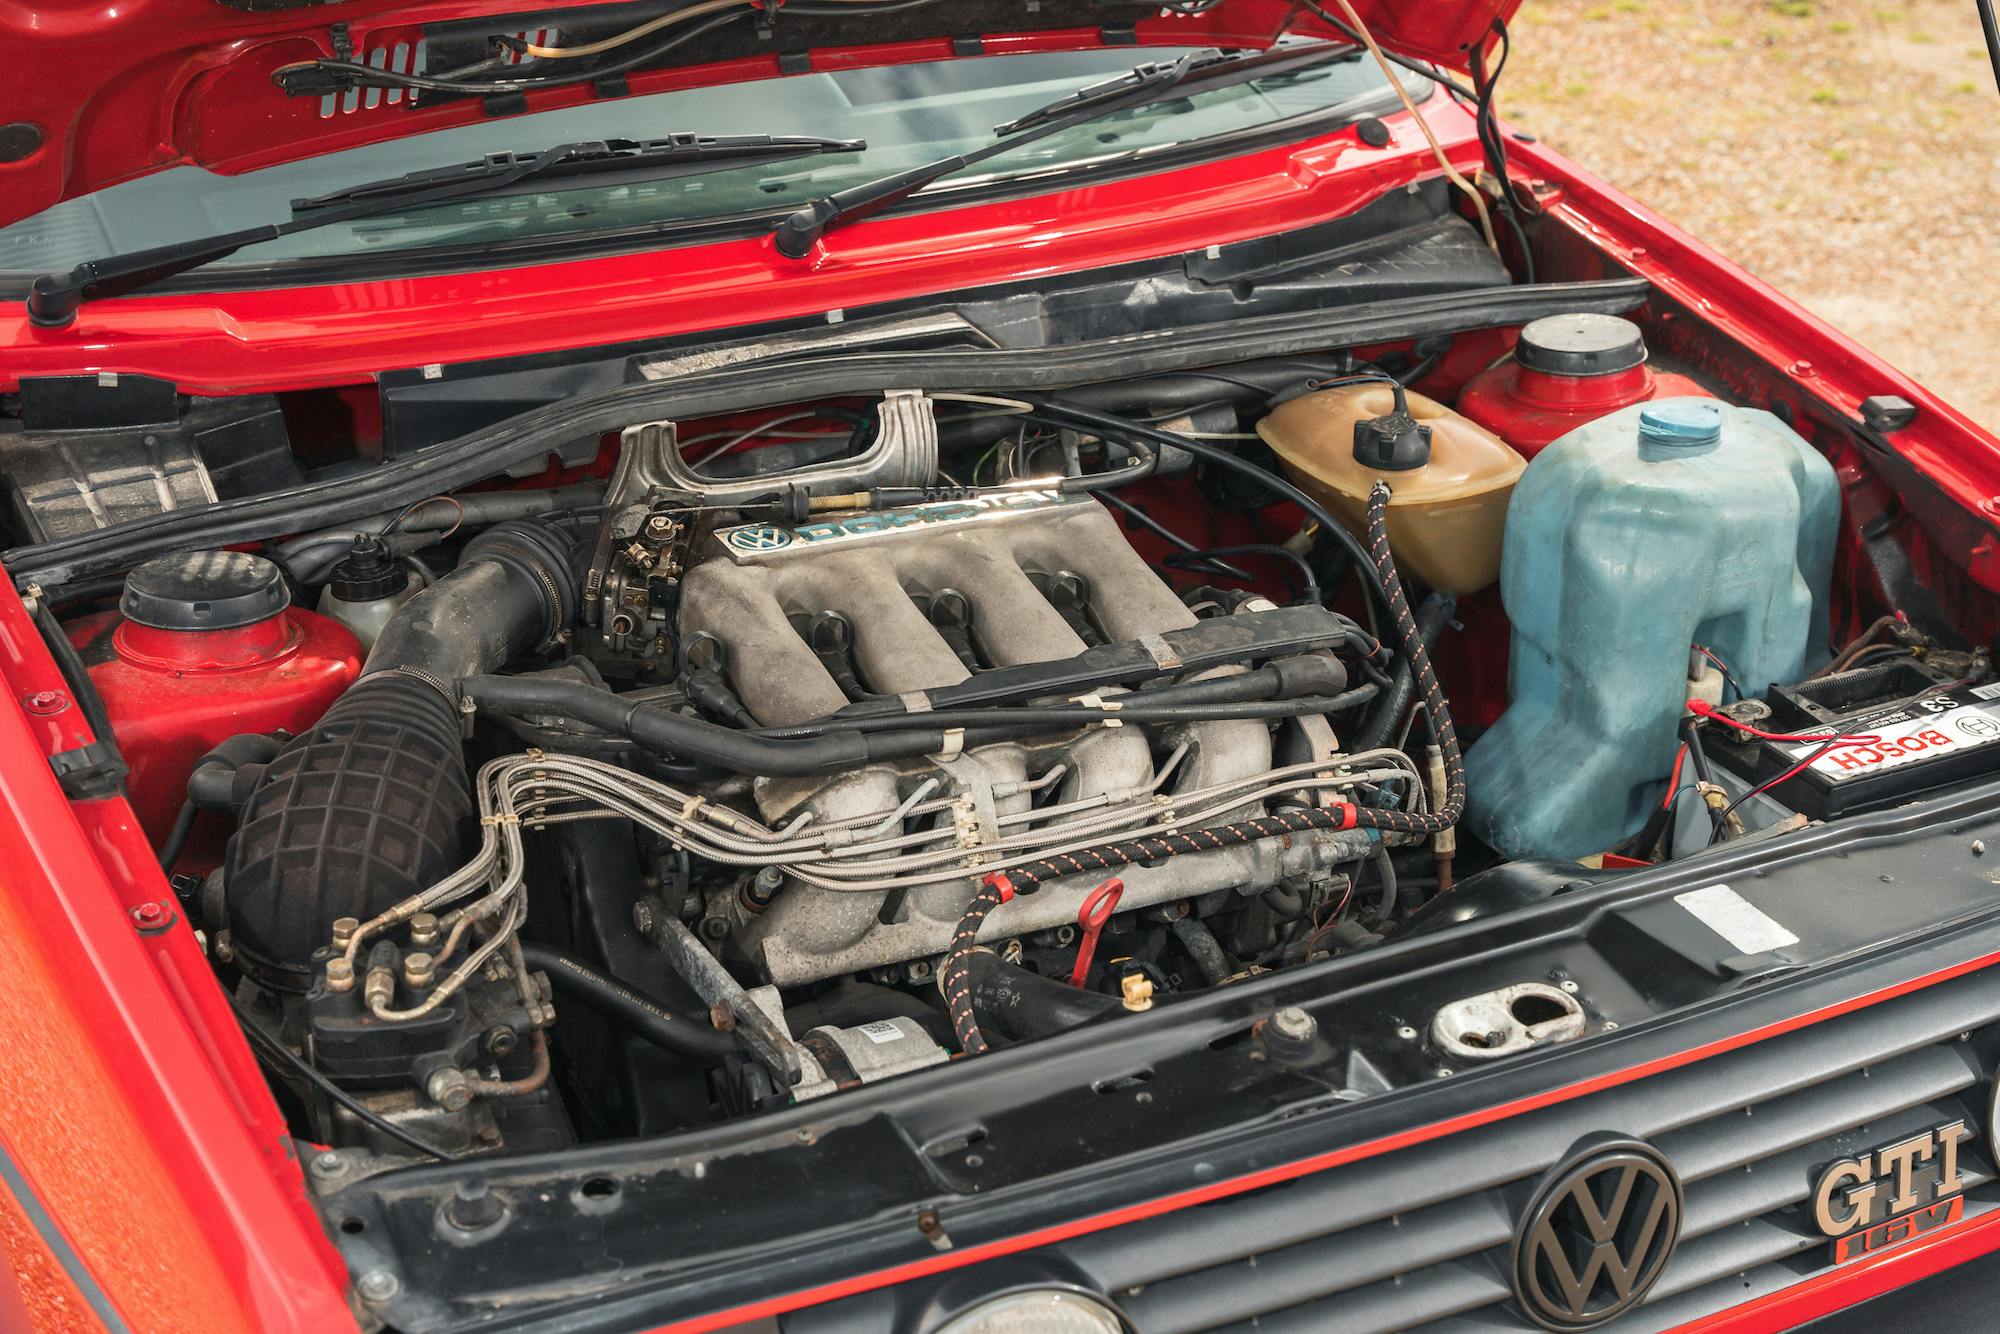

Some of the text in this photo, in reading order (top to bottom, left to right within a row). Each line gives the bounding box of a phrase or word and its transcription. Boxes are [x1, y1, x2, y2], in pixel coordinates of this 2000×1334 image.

[1919, 696, 1959, 713] S3
[1828, 729, 1953, 770] BOSCH
[1815, 1120, 1965, 1237] GTI
[1527, 1152, 1677, 1320] VW
[1844, 1199, 1954, 1261] 16V
